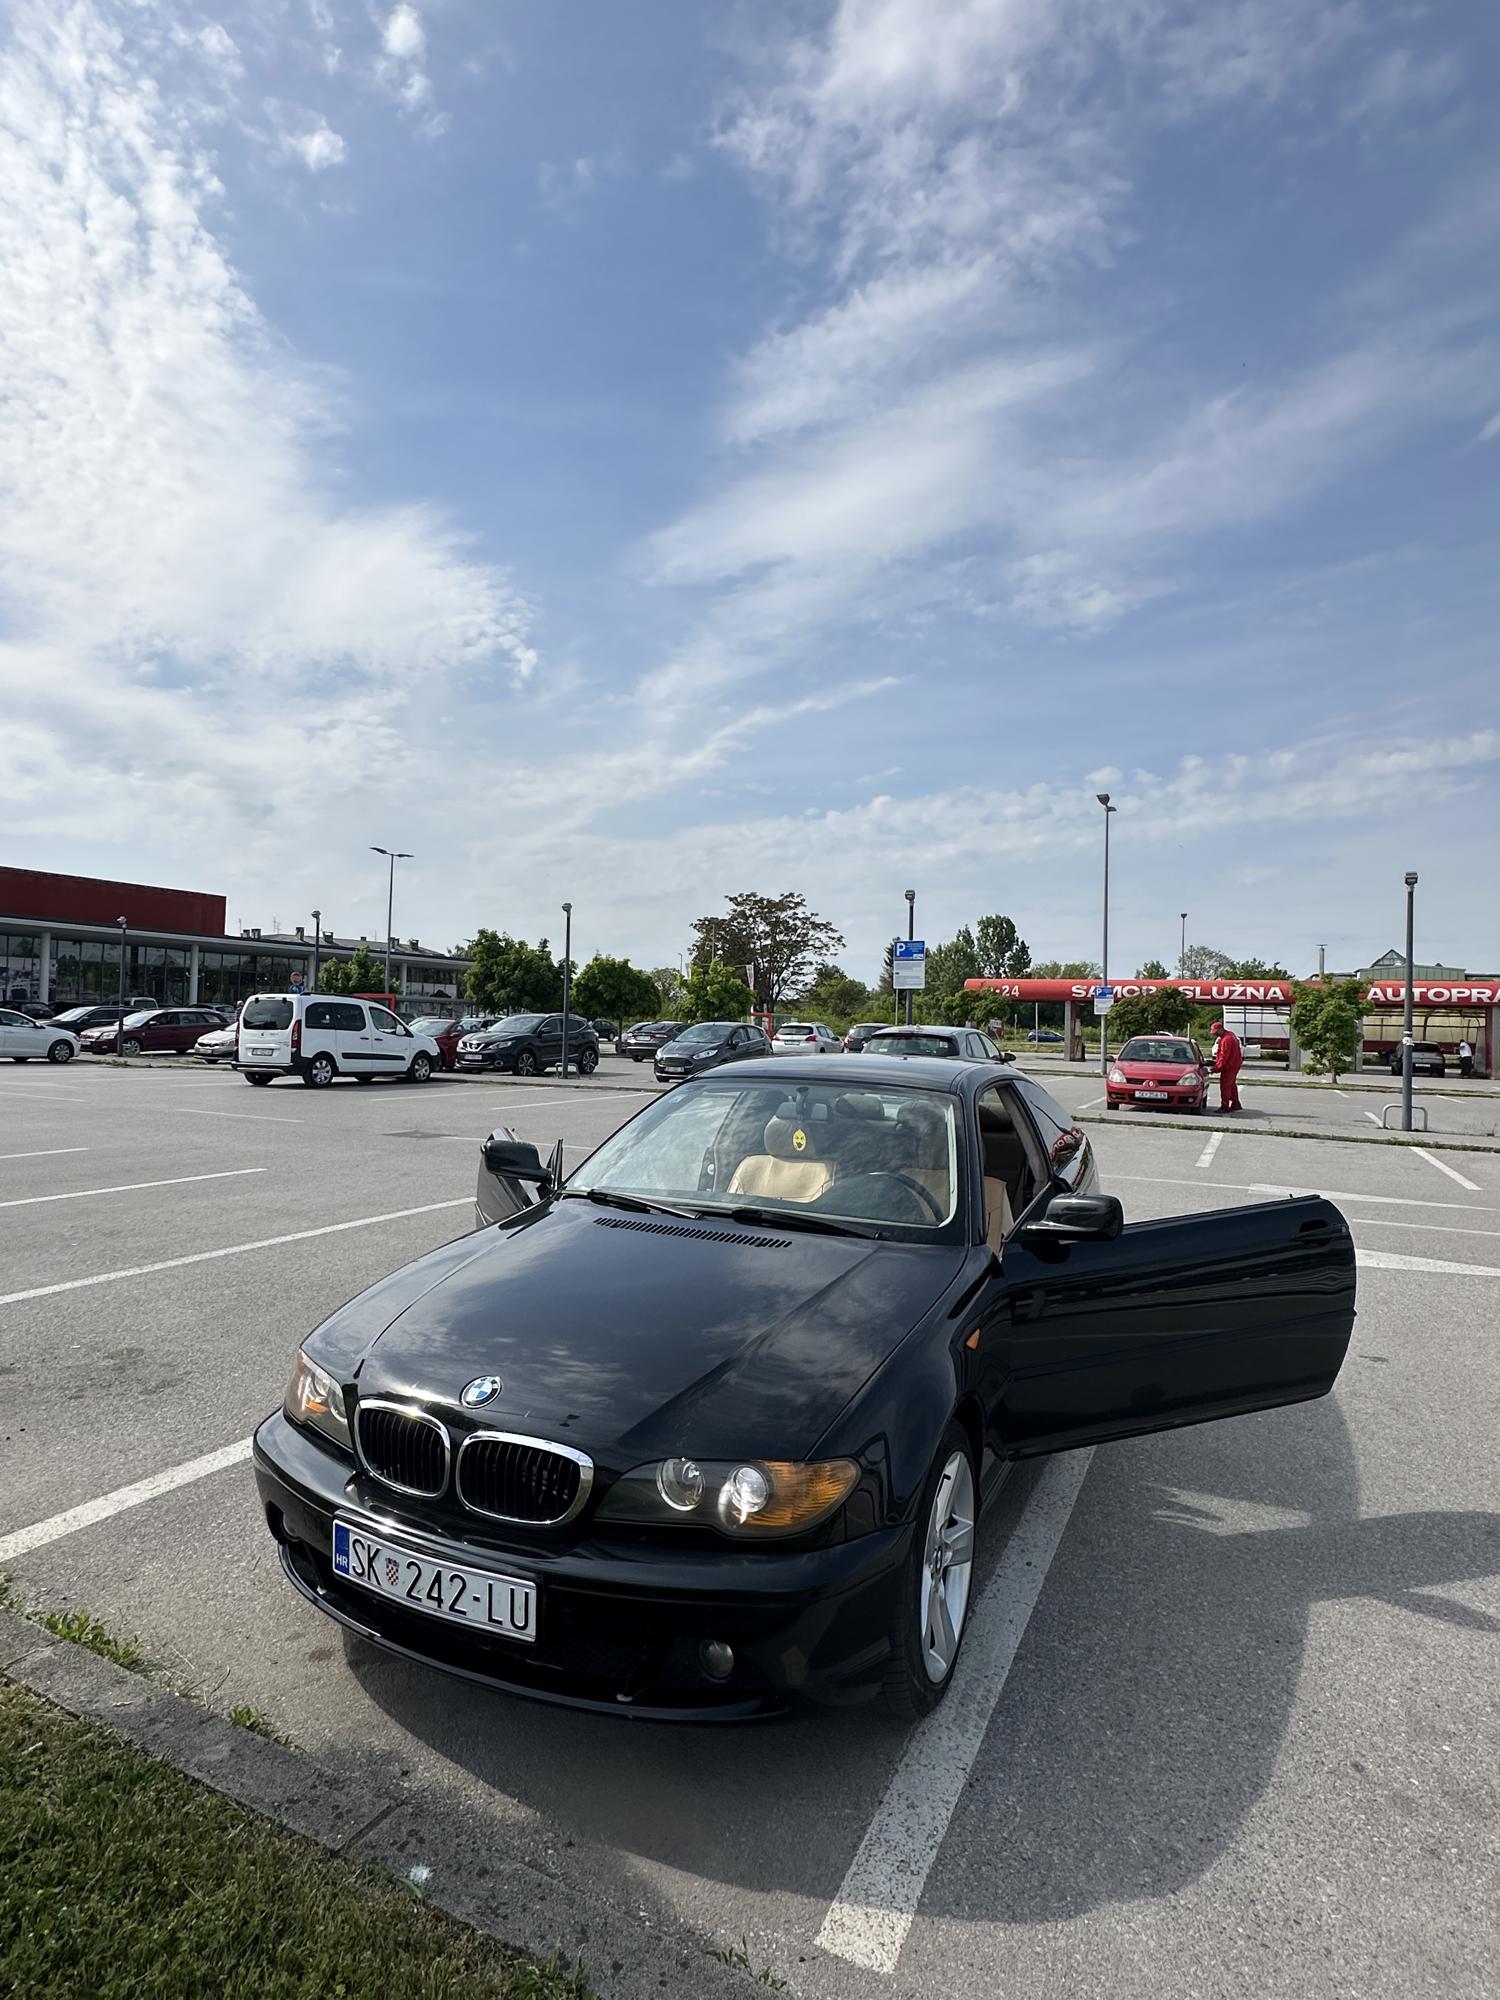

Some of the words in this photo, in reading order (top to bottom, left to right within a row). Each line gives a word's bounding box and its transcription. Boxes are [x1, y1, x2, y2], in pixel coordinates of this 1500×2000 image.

[896, 942, 906, 957] P
[990, 984, 1020, 998] -24
[1071, 983, 1285, 1001] SAMOPSLUŽNA
[1366, 987, 1500, 1003] AUTOPR
[336, 1553, 349, 1569] HR
[351, 1537, 383, 1586] SK
[405, 1560, 530, 1631] 242-LU
